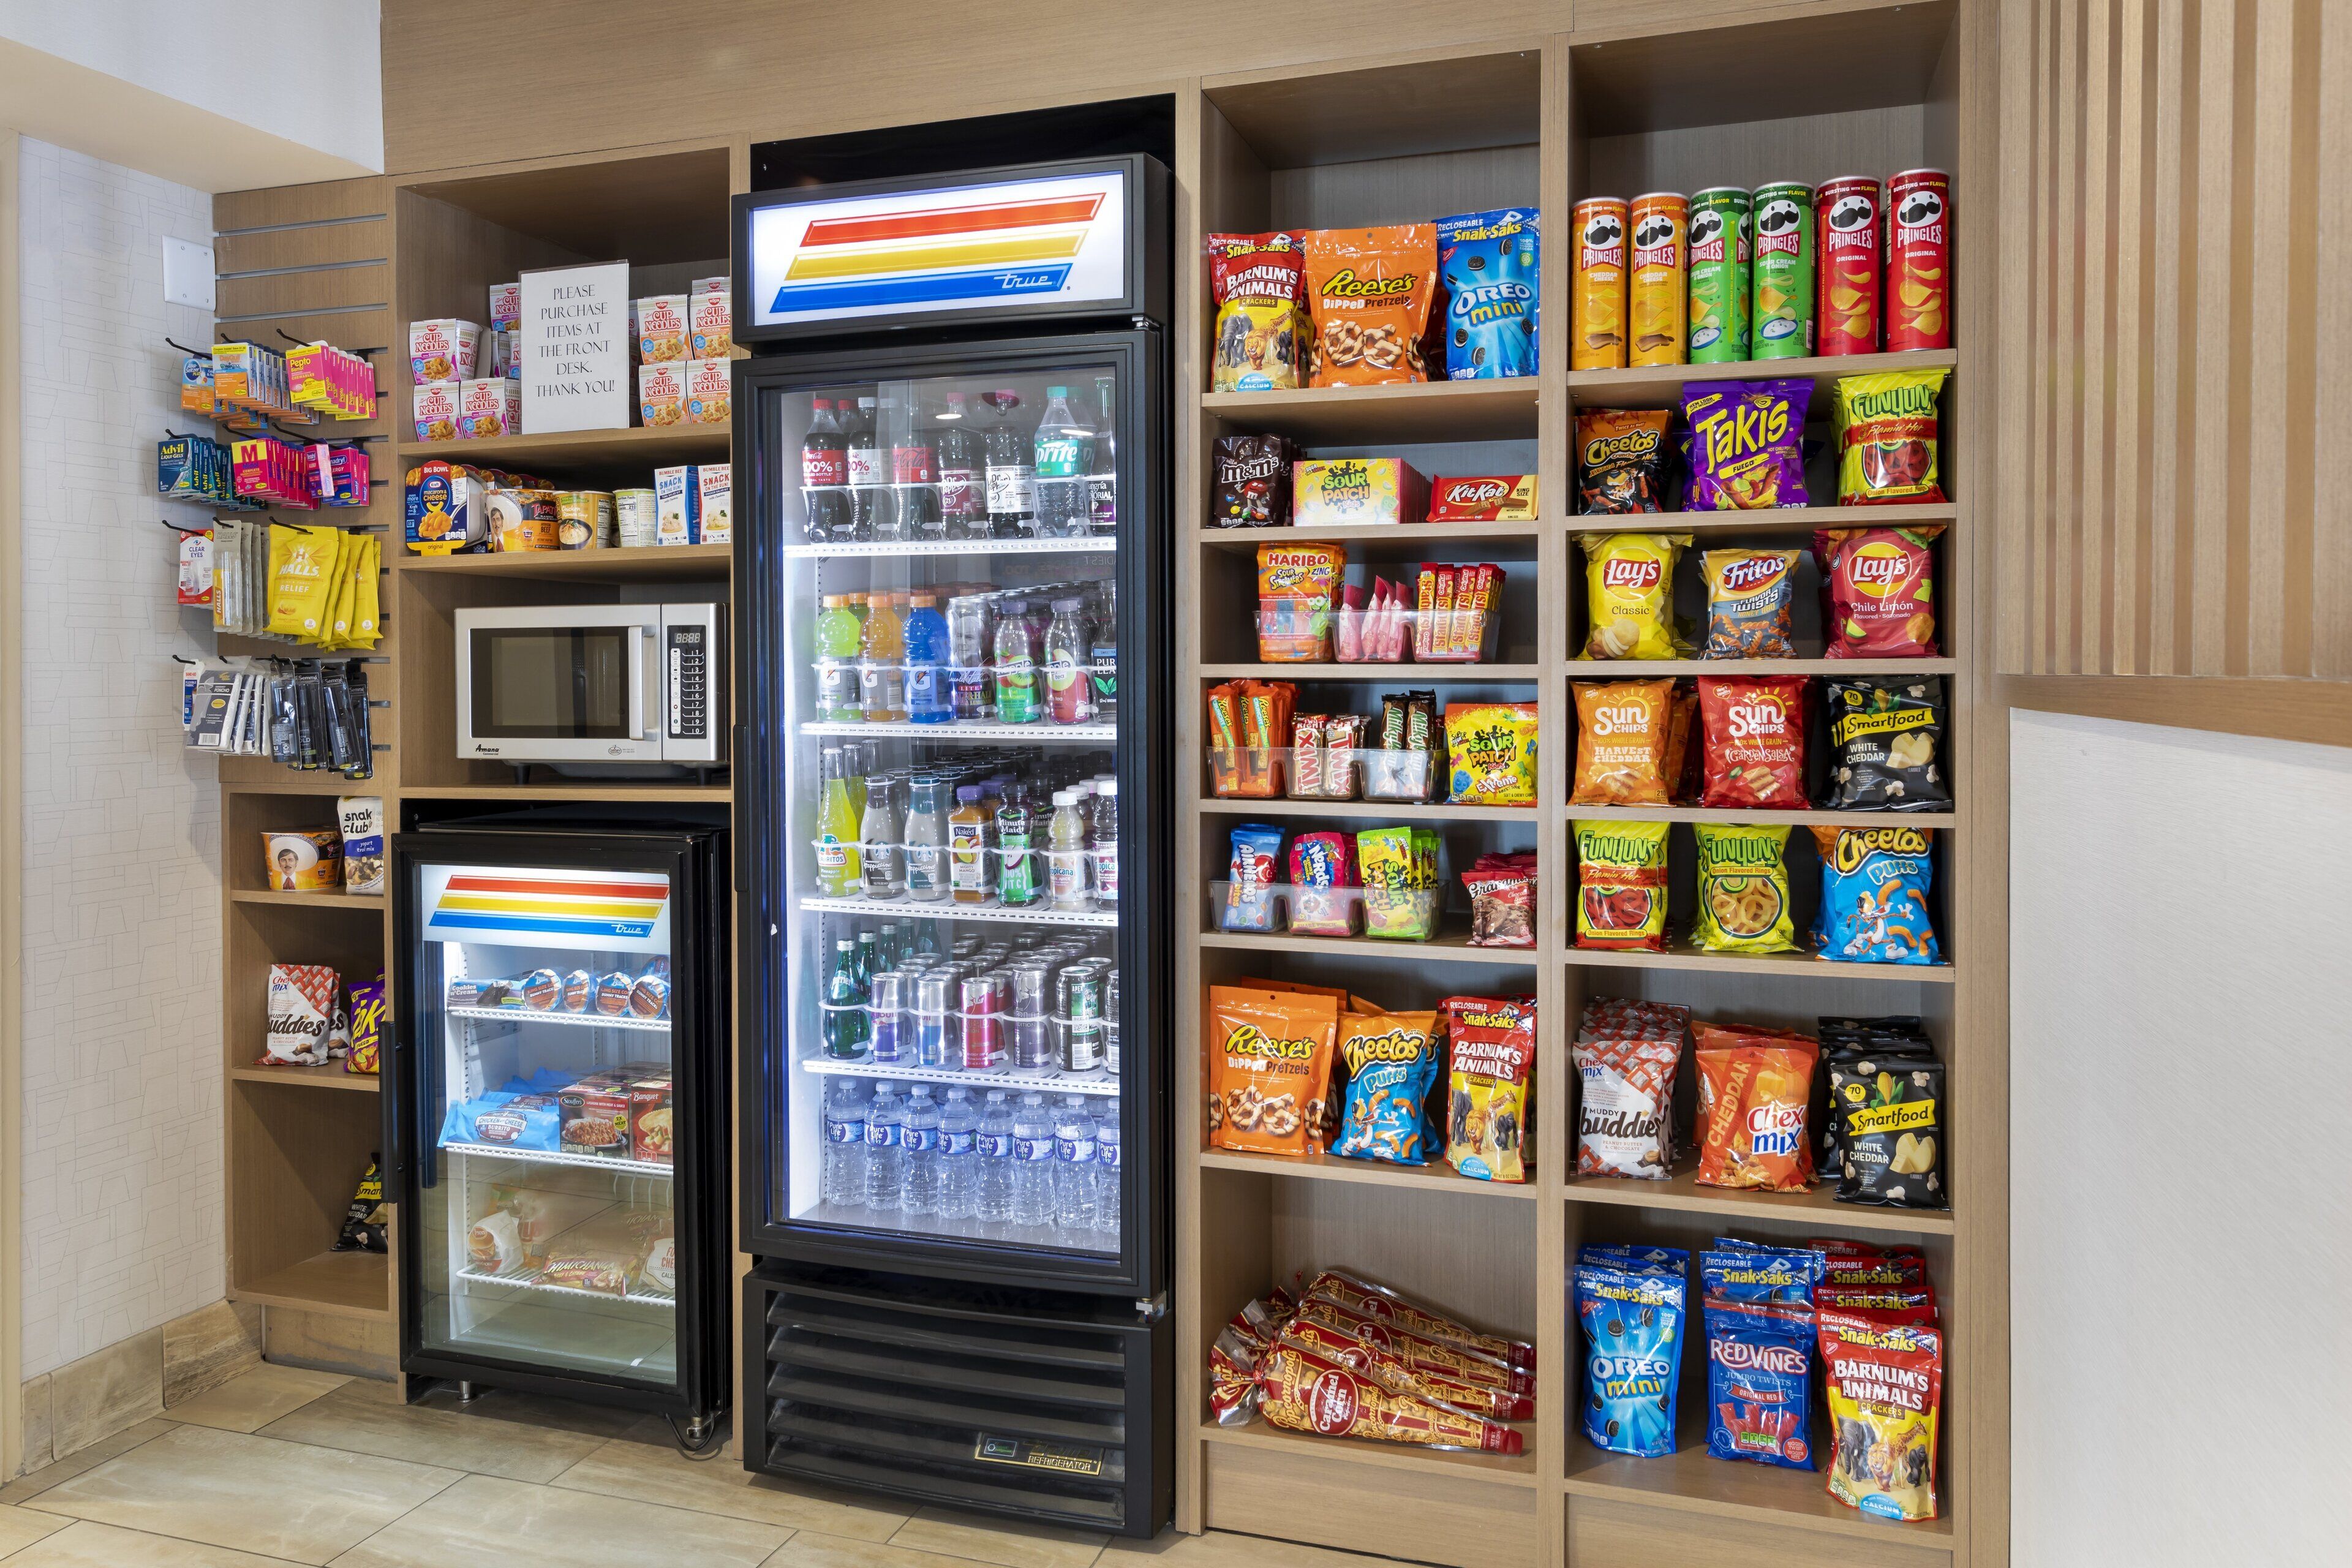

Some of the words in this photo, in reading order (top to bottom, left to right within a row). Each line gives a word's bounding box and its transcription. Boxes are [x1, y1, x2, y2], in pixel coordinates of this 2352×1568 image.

[1825, 187, 1850, 196] BURSTING
[1453, 222, 1521, 242] Snak-Saks
[1583, 248, 1622, 270] PRINGLES
[1635, 247, 1673, 270] PRINGLES
[994, 273, 1053, 288] true
[1226, 265, 1297, 292] BARNUM'S
[1322, 269, 1417, 296] Reese's
[554, 284, 595, 300] PLEASE
[1226, 281, 1292, 301] ANIMALS
[1455, 284, 1530, 314] OREO
[541, 303, 608, 320] PURCHASE
[1471, 299, 1522, 326] mini
[423, 333, 442, 342] CUP
[546, 324, 583, 338] ITEMS
[587, 322, 602, 336] AT
[415, 341, 449, 352] NOODLES
[538, 344, 562, 357] THE
[566, 340, 611, 356] FRONT
[557, 363, 592, 375] DESK.
[535, 383, 581, 397] THANK
[585, 380, 615, 393] YOU!
[161, 444, 184, 454] Advil
[1035, 442, 1077, 460] Sprite
[1587, 432, 1656, 461] Cheetos
[1733, 461, 1754, 473] FUEGO
[660, 476, 682, 489] SNACK
[703, 473, 729, 486] SNACK
[1324, 473, 1366, 488] SOUR
[1322, 486, 1370, 505] PATCH
[1268, 554, 1327, 567] HARIBO
[280, 564, 318, 576] HALLS
[1605, 559, 1657, 586] Lay's
[1723, 556, 1785, 589] Fritos
[1854, 557, 1906, 586] Lay's
[281, 584, 309, 593] RELIEF
[1740, 590, 1771, 605] FLAVOR
[1851, 603, 1876, 611] Chile
[1880, 601, 1913, 611] Limón
[1611, 605, 1649, 616] Classic
[1384, 707, 1403, 745] Milky
[1594, 706, 1649, 735] Sun
[1613, 725, 1648, 733] CHIPS
[1847, 711, 1925, 734] Smartfood
[1595, 747, 1650, 755] HARVEST
[1850, 743, 1877, 753] WHITE
[1298, 732, 1321, 793] TWIX
[1469, 752, 1516, 766] PATCH
[1847, 753, 1885, 764] CHEDDAR
[344, 809, 372, 821] snak
[344, 823, 368, 833] club
[1583, 831, 1657, 866] FUNYUNS
[1233, 885, 1242, 907] bites
[1225, 1025, 1316, 1060] Reese's
[1453, 1043, 1521, 1065] BARNUM'S
[1453, 1057, 1513, 1079] ANIMALS
[505, 1118, 523, 1127] CHEESE
[830, 1122, 843, 1132] Pure
[1580, 1107, 1661, 1137] buddies
[1749, 1107, 1804, 1132] Chex
[1858, 1107, 1928, 1131] Smartfood
[830, 1129, 841, 1137] Life
[1755, 1128, 1801, 1154] mix
[1854, 1142, 1882, 1153] WHITE
[1850, 1152, 1889, 1164] CHEDDAR
[1706, 1257, 1751, 1267] RECLOSEABLE
[1722, 1268, 1792, 1285] Snak-Saks
[1593, 1357, 1670, 1379] OREO
[1607, 1377, 1661, 1396] mini
[1726, 1372, 1755, 1381] JUMBO
[1757, 1376, 1791, 1386] TWISTS
[1320, 1374, 1339, 1431] Caramel
[1740, 1390, 1765, 1400] ORIGINAL
[1332, 1389, 1347, 1423] Corn
[1028, 1455, 1090, 1471] REFRIGERATOR
